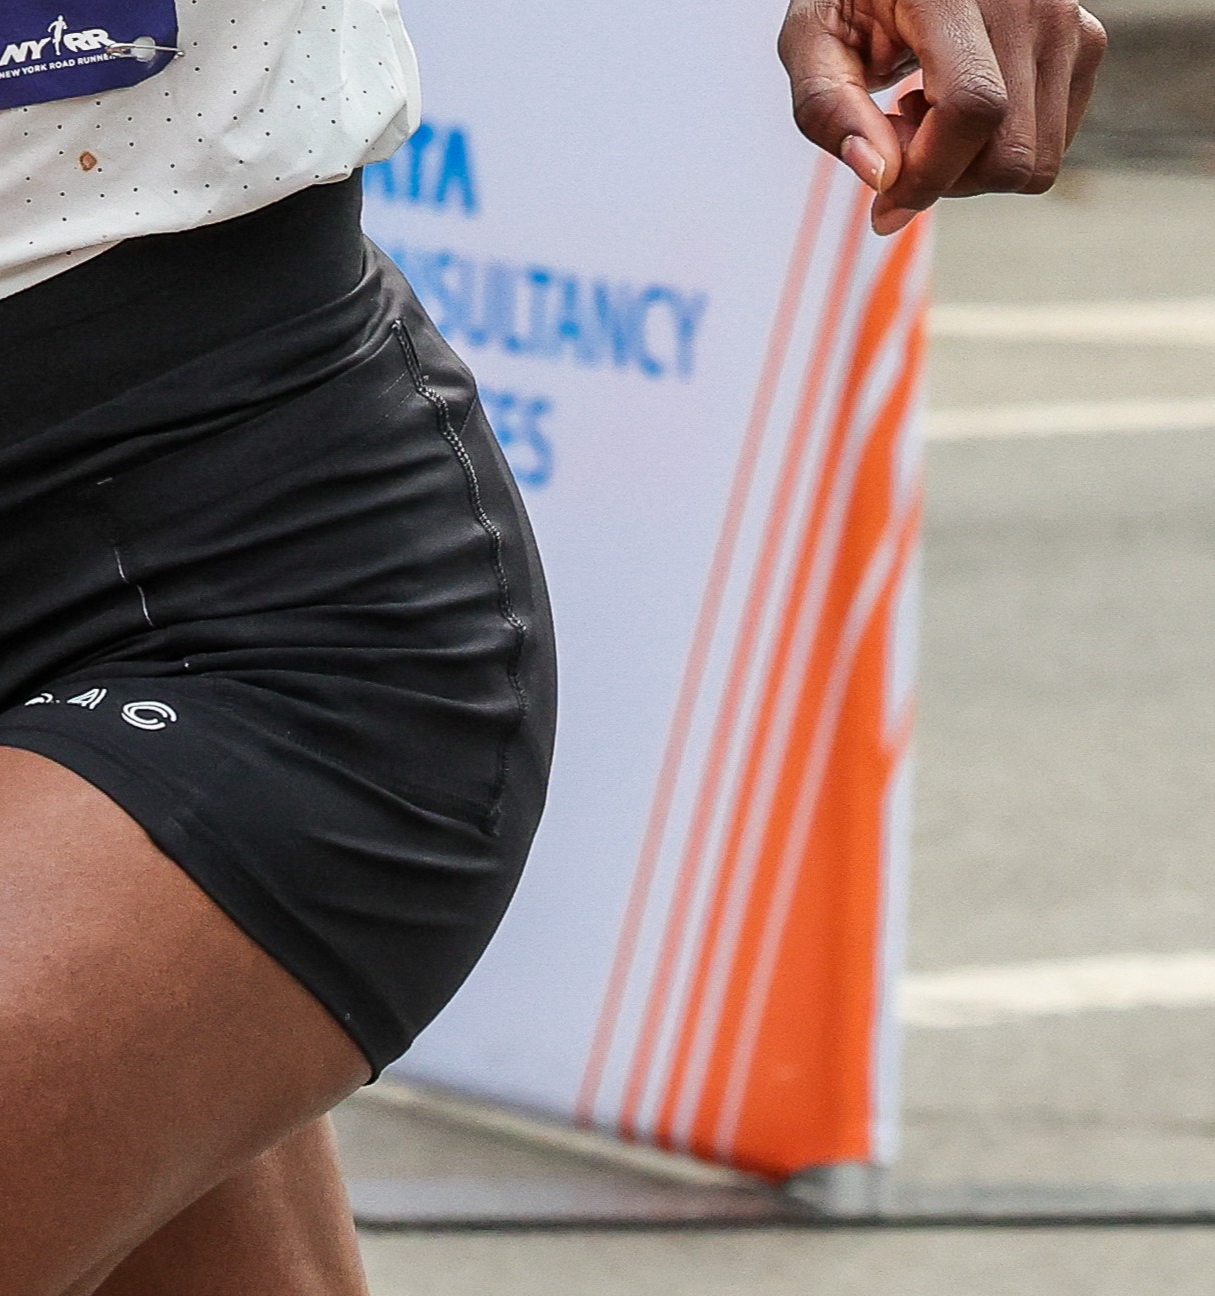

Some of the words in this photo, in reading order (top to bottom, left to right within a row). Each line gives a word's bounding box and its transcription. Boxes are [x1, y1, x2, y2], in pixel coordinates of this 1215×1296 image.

[21, 64, 48, 76] YORK
[49, 59, 75, 71] ROAD
[77, 53, 116, 66] RUNNE
